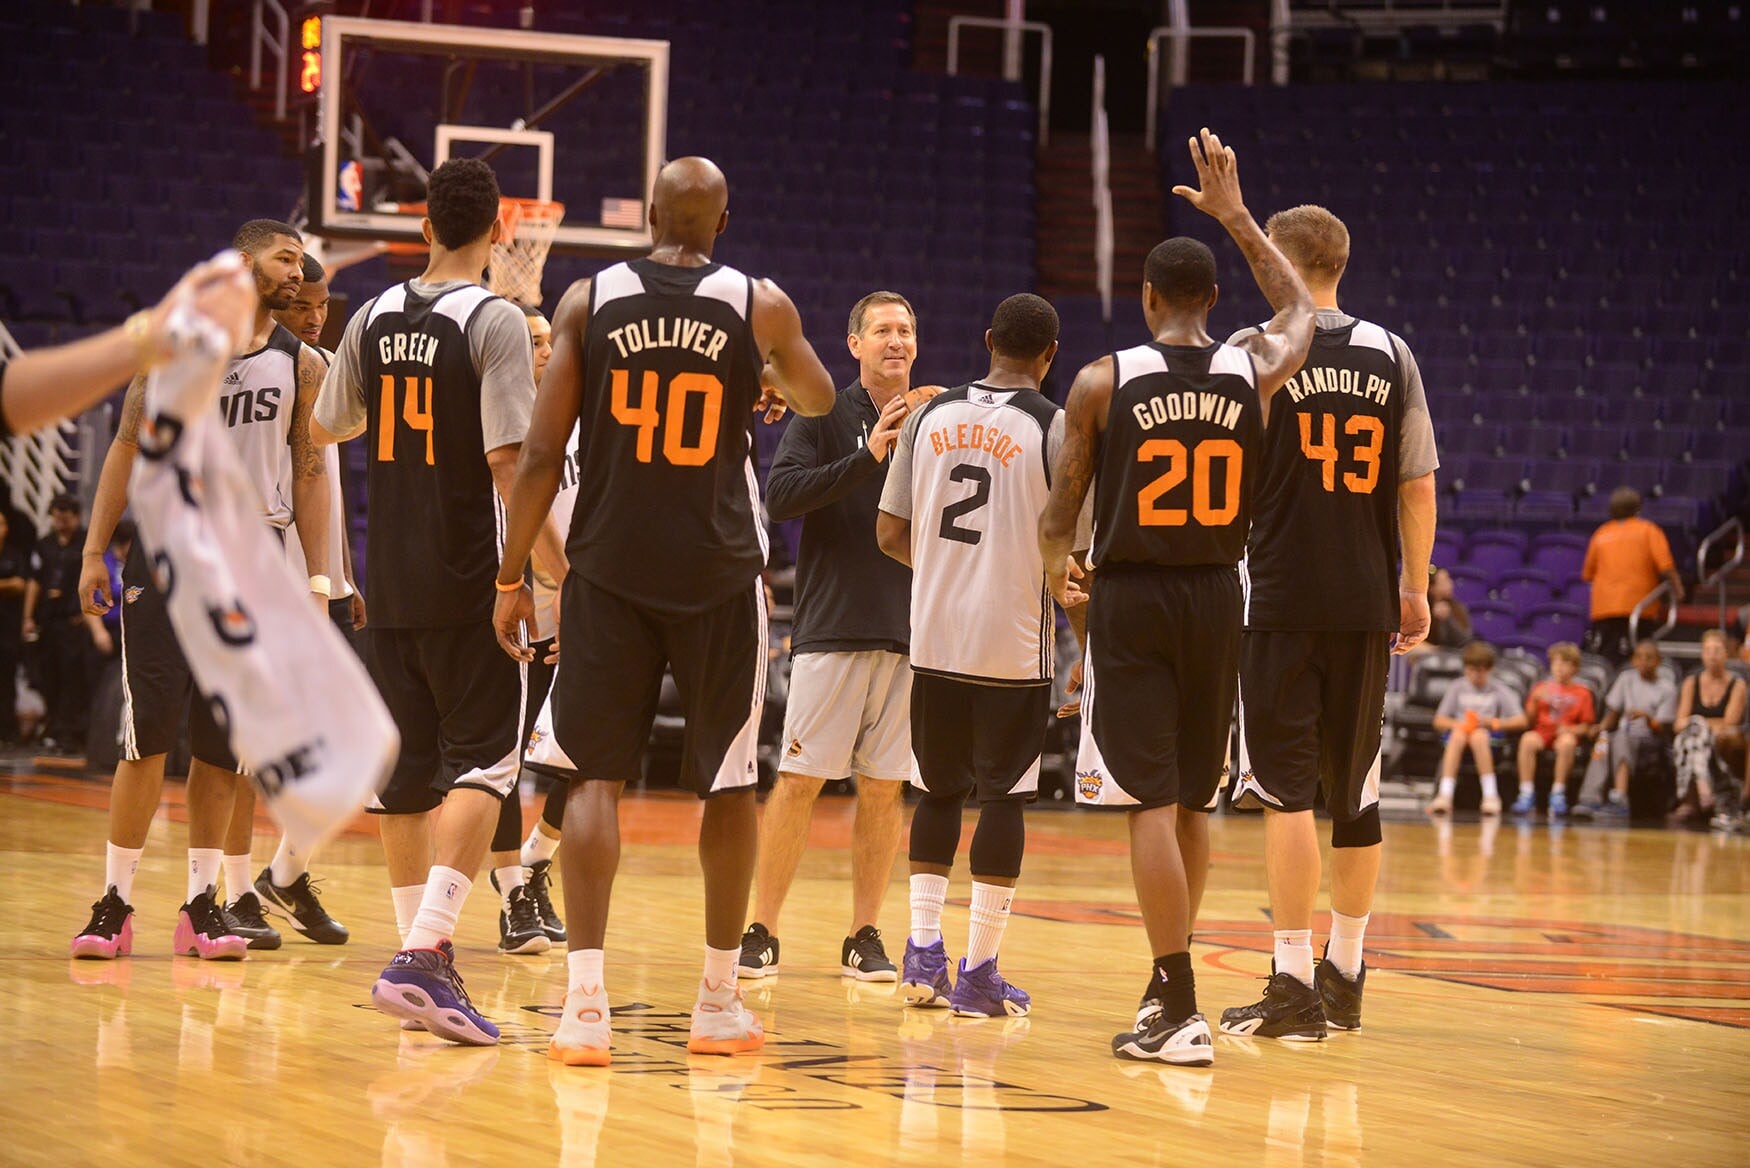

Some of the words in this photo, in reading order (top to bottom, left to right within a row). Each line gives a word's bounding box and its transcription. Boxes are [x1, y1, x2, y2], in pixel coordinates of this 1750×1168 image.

[378, 332, 440, 367] GREEN
[607, 317, 729, 362] TOLLIVER
[1284, 367, 1392, 406] RANDOLPH
[377, 374, 436, 466] 14
[610, 369, 724, 467] 40
[1132, 391, 1244, 431] GOODWIN
[929, 423, 1024, 469] BLEDSOE
[1296, 412, 1385, 495] 43
[939, 463, 992, 546] 2
[1137, 439, 1243, 526] 20
[1080, 783, 1098, 793] PHX
